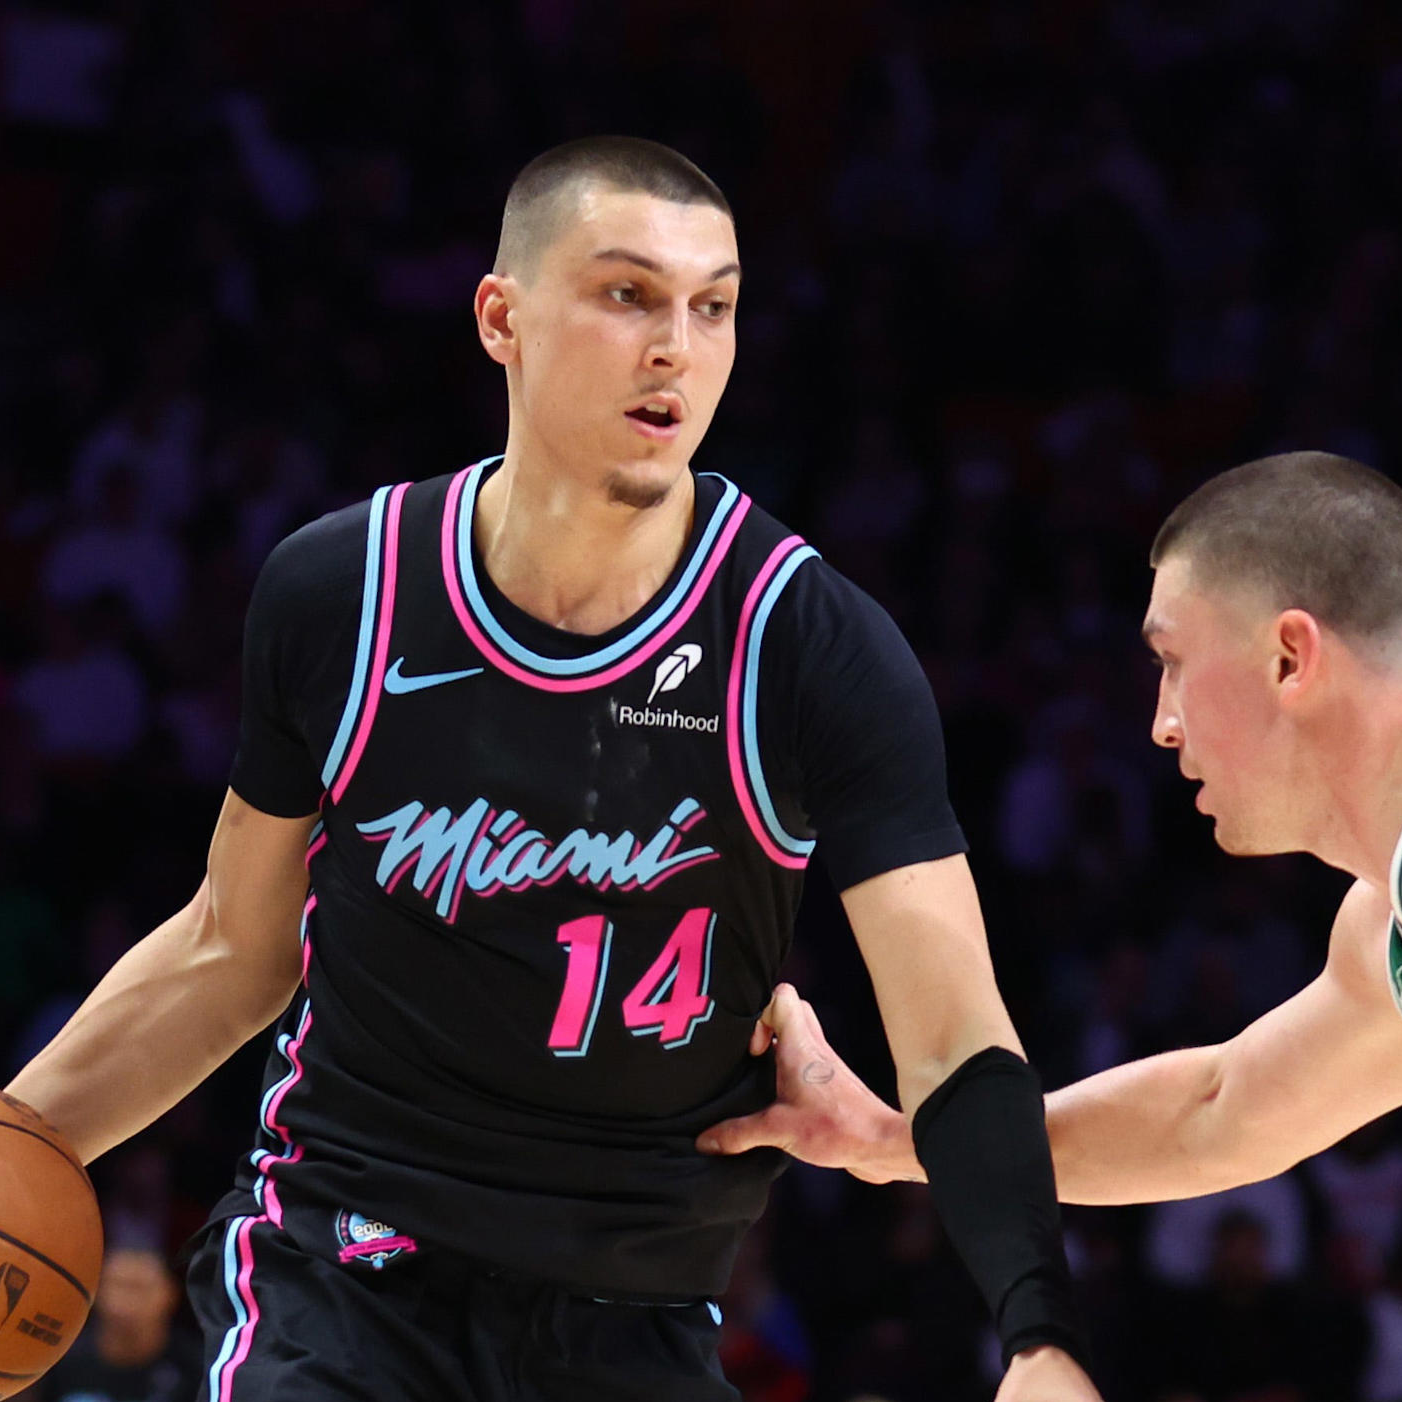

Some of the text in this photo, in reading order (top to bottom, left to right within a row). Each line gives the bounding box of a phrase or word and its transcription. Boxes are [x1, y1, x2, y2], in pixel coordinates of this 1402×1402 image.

[618, 704, 719, 734] Robinhood
[354, 796, 721, 925] Miami
[546, 906, 717, 1059] 14
